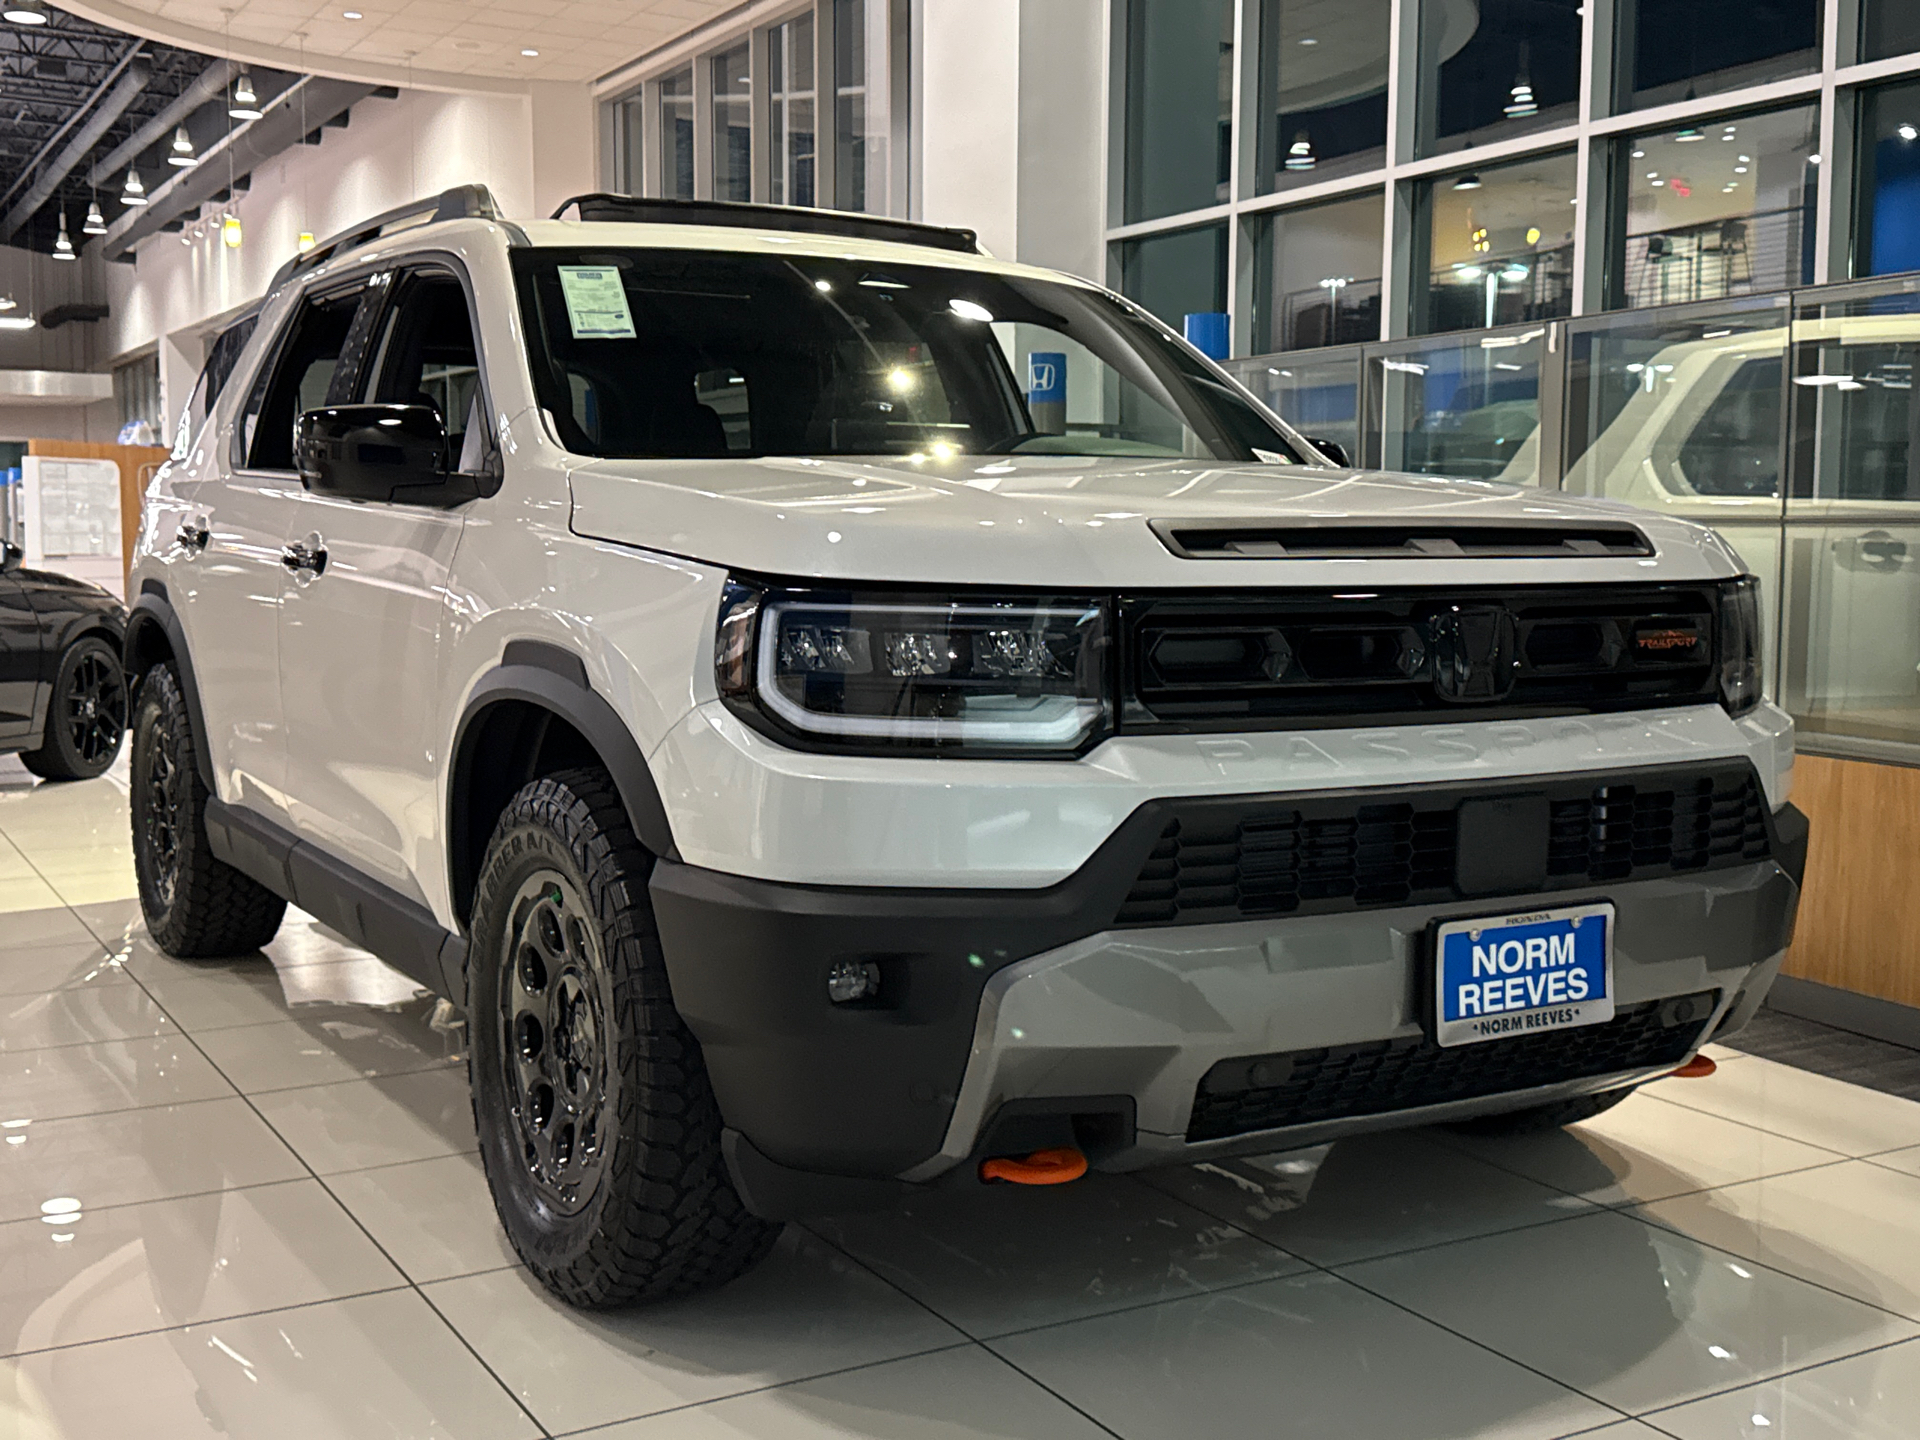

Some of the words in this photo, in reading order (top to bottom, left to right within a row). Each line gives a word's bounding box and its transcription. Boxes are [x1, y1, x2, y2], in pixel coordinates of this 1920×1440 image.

[1472, 933, 1576, 977] NORM
[1458, 967, 1589, 1017] REEVES
[1481, 1015, 1523, 1035] NORM
[1526, 1008, 1574, 1028] REEVES
